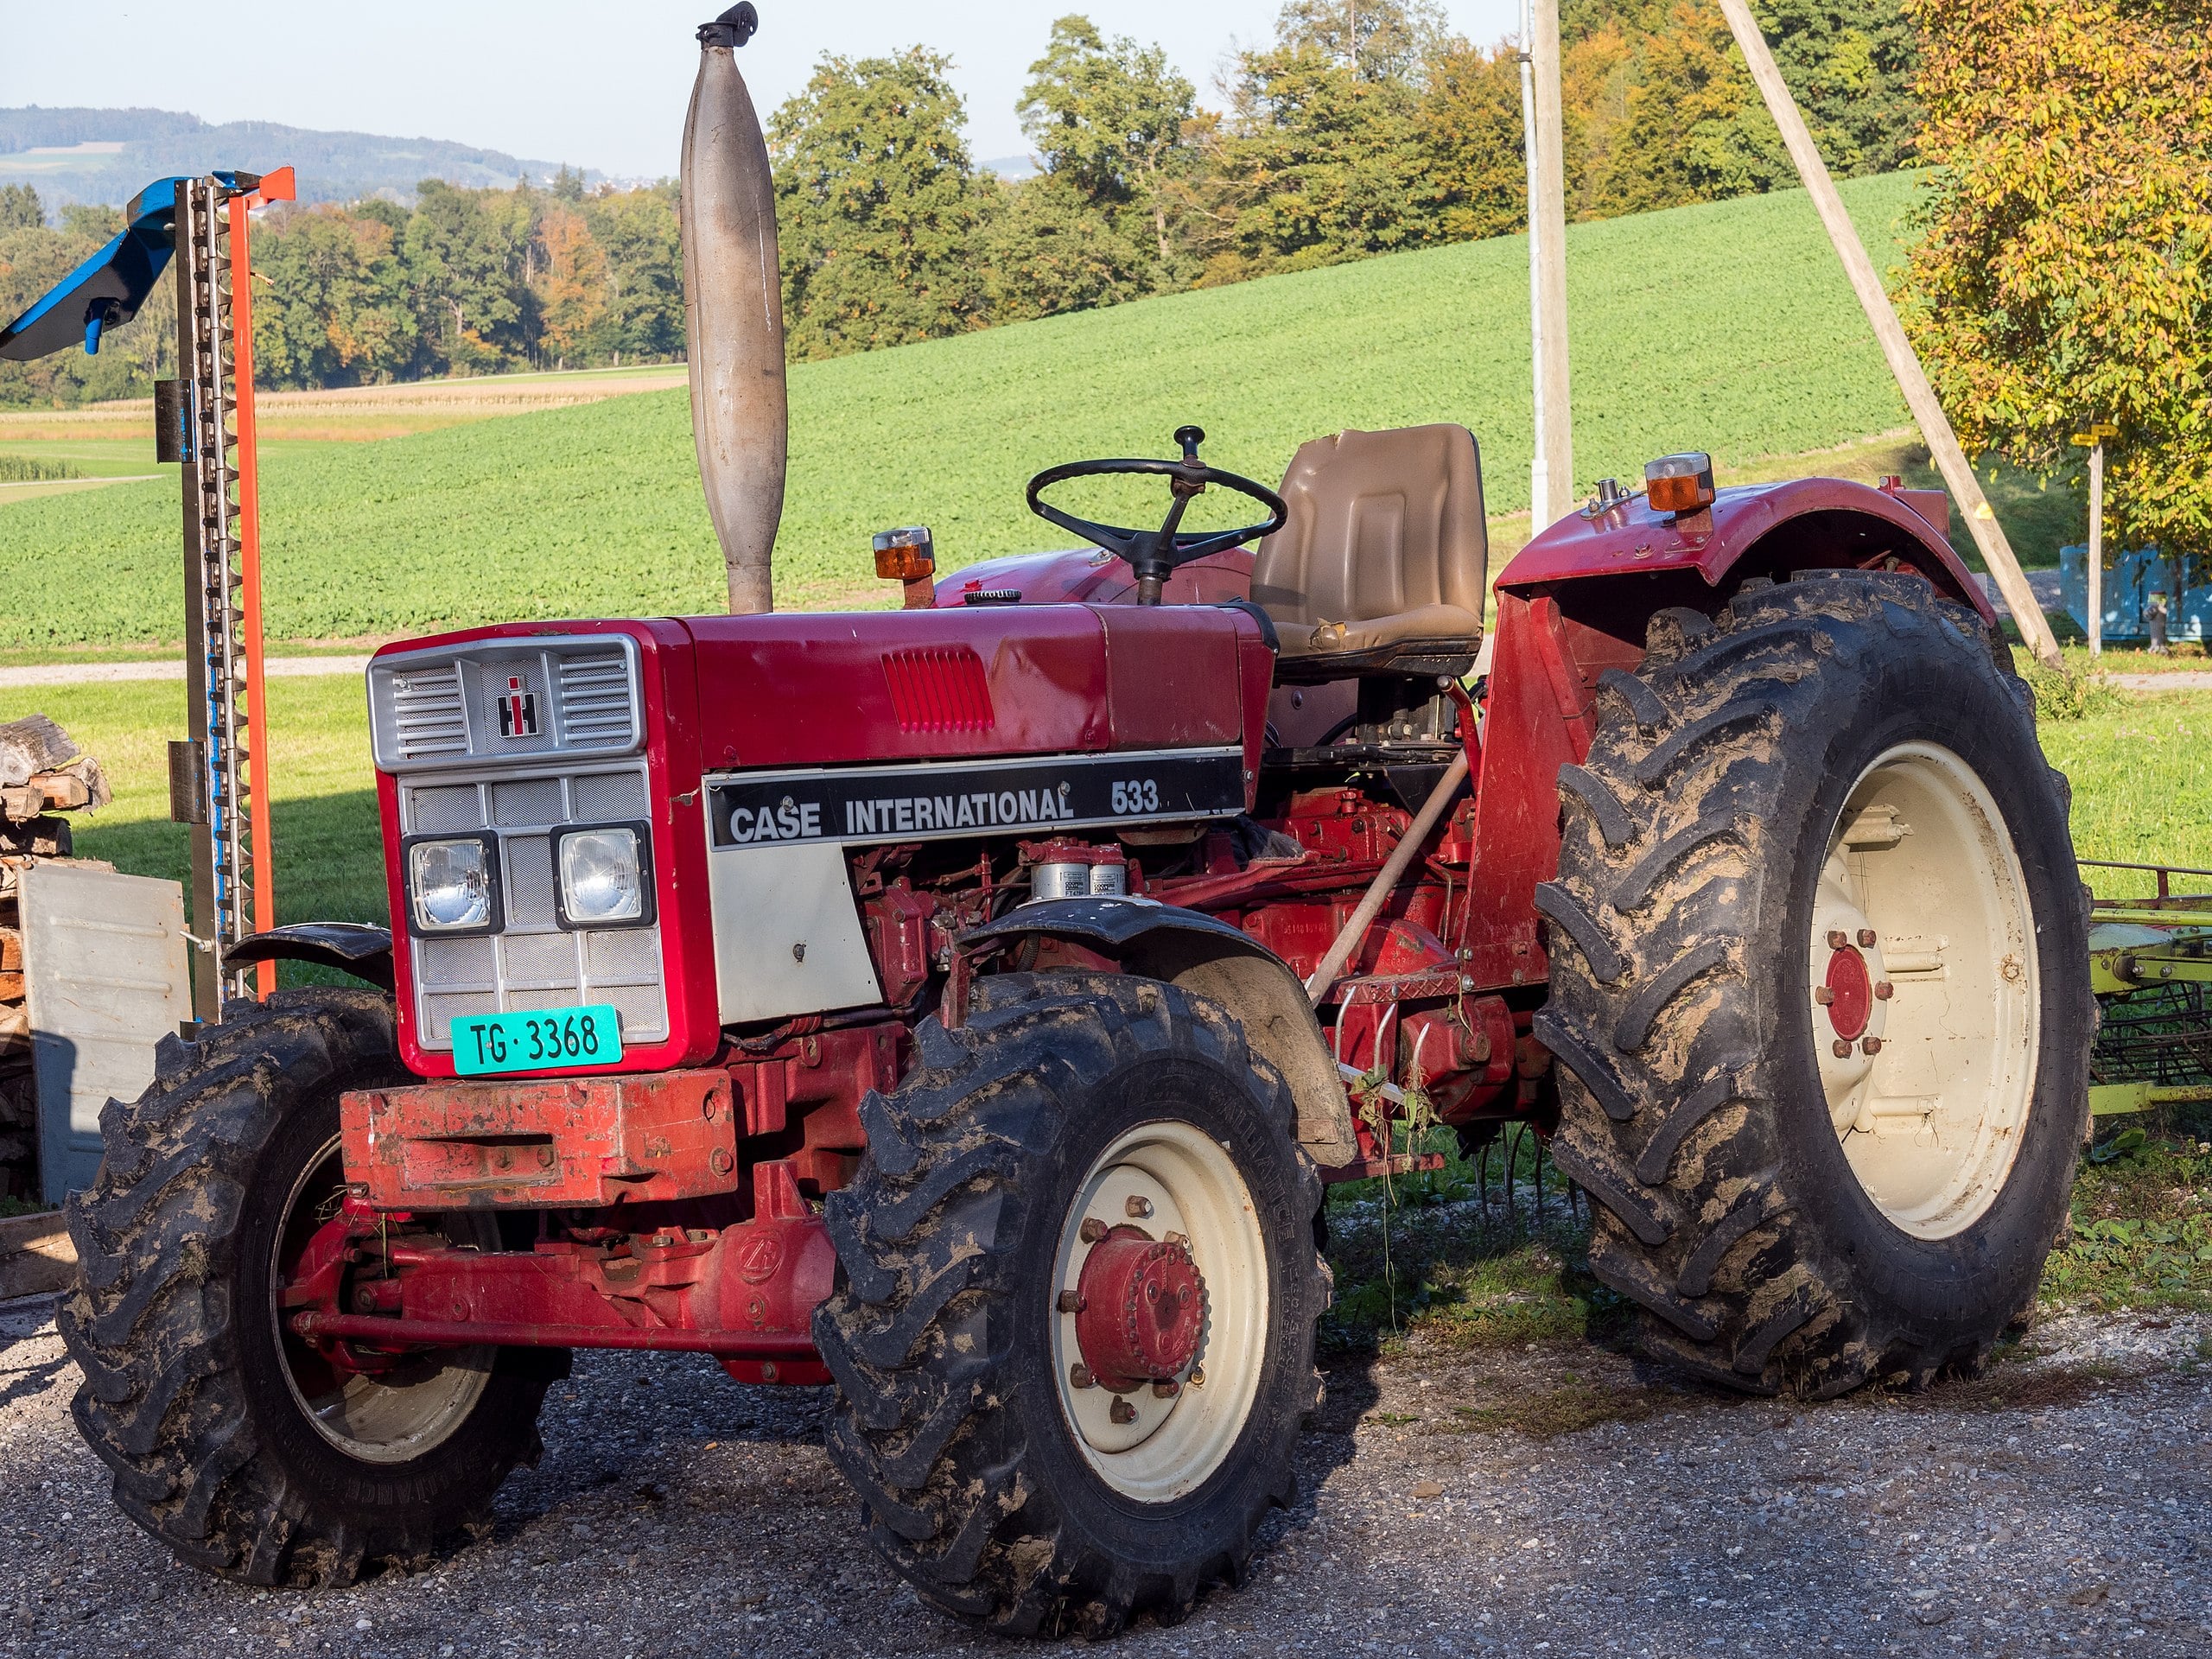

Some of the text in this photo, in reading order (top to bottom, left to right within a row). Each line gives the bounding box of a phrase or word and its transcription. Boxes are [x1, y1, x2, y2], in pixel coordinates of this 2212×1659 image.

[730, 779, 1160, 843] CASE INTERNATIONAL 533
